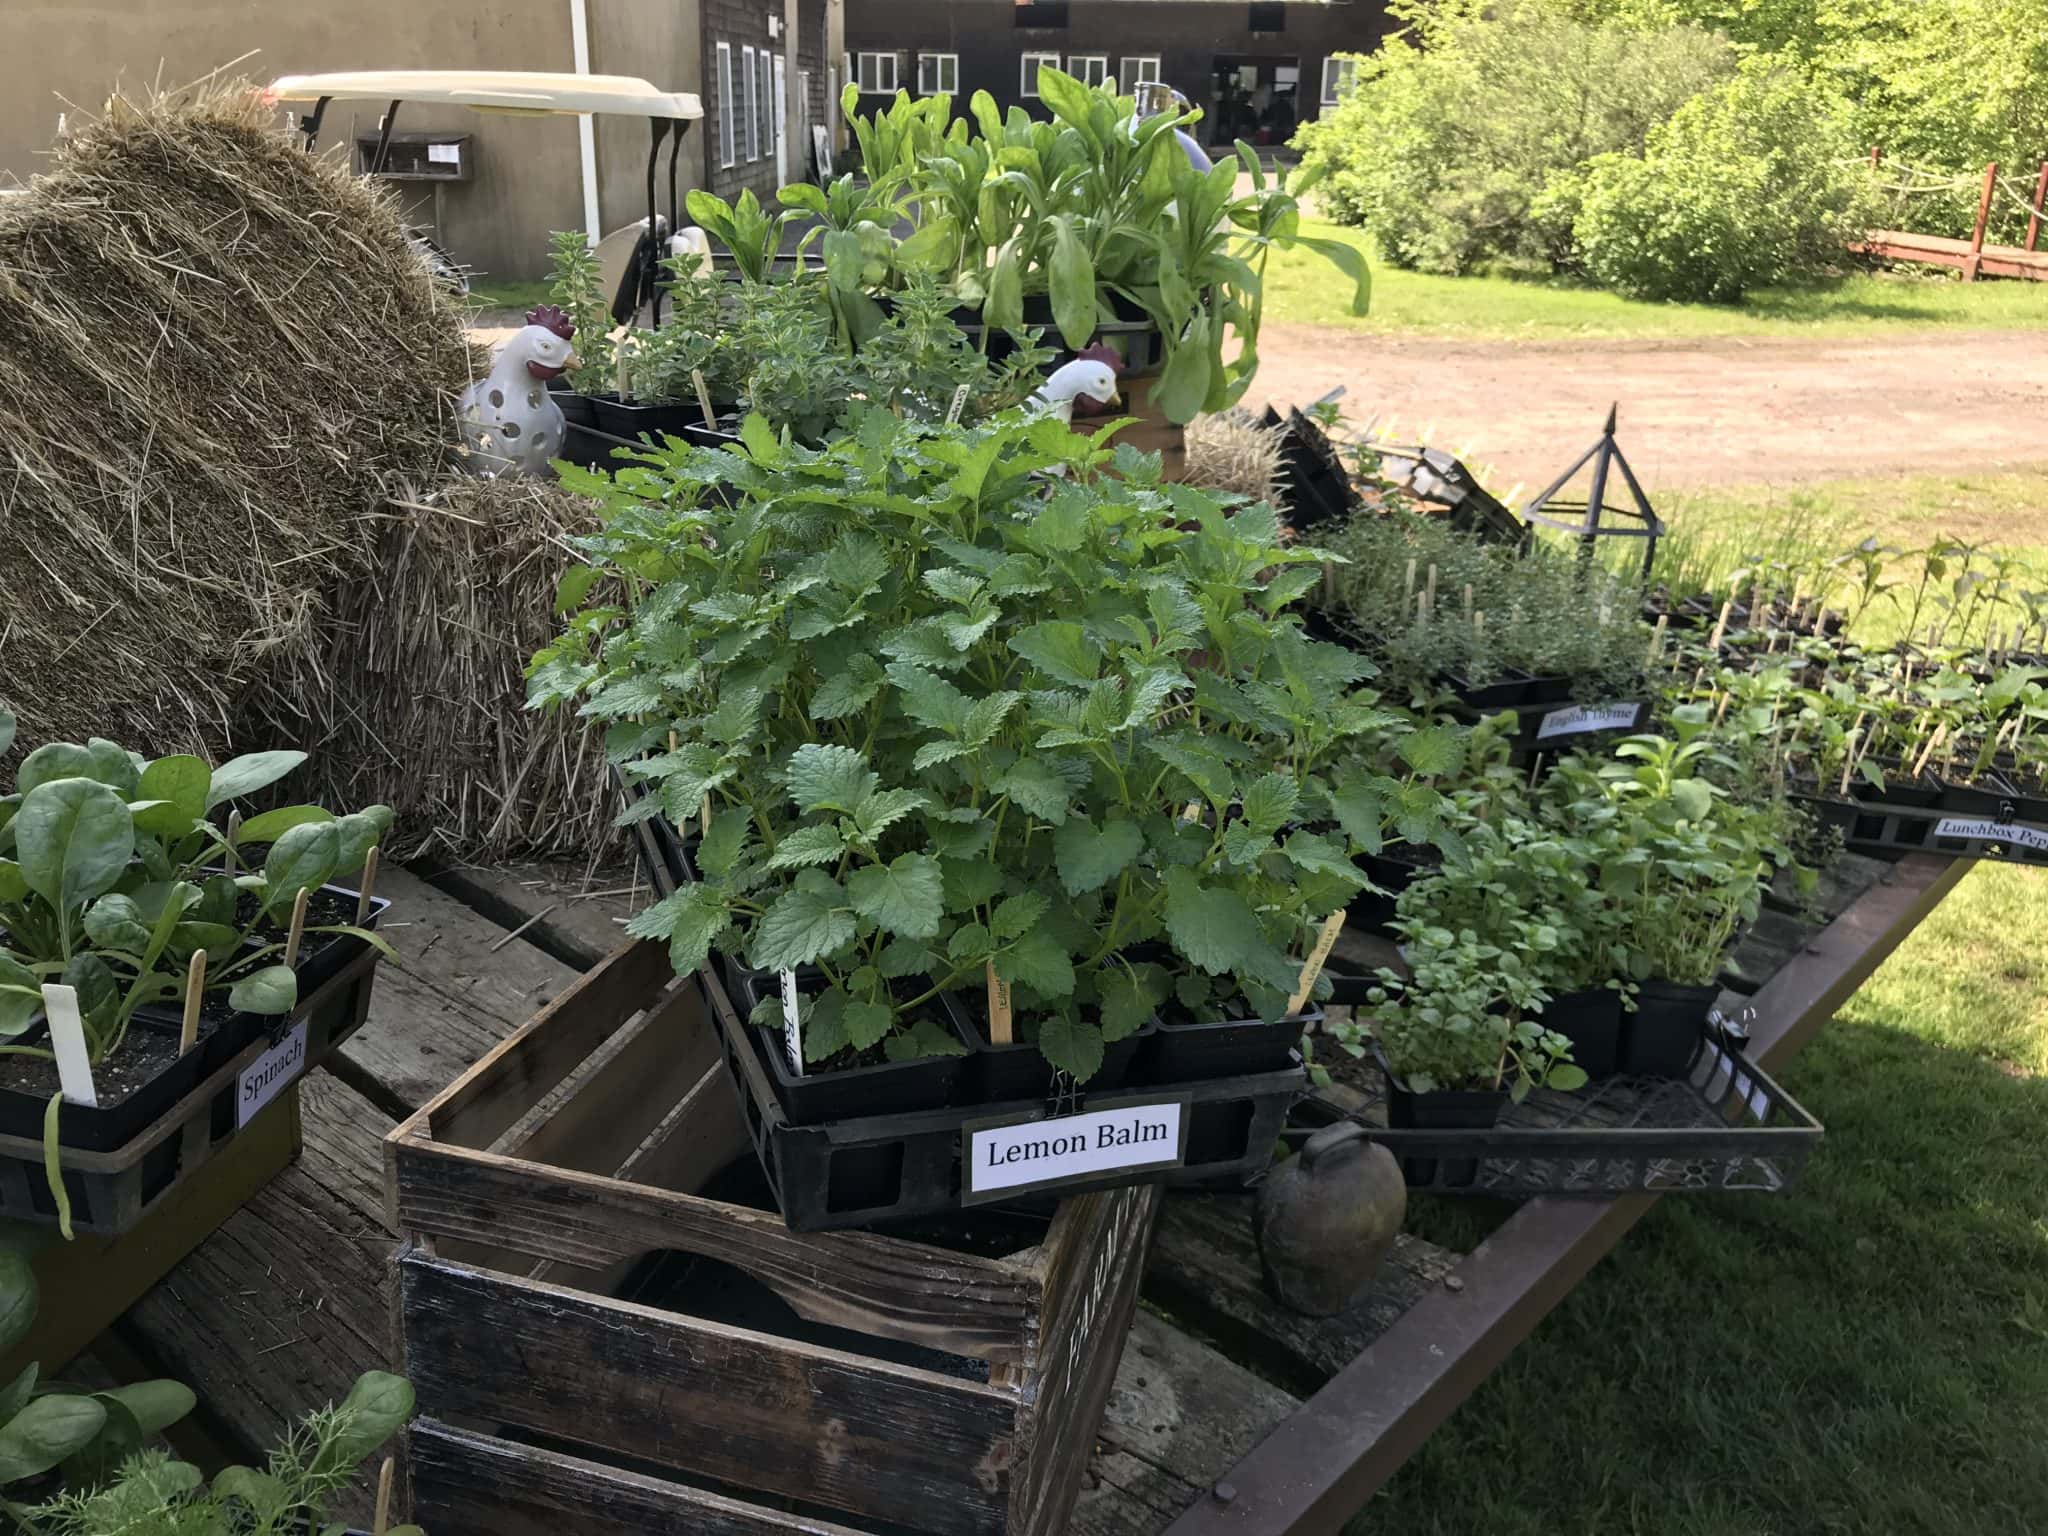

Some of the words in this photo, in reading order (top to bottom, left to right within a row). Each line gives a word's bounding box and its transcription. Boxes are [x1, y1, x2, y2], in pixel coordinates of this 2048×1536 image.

[1942, 821, 2014, 839] Lunchbox
[2019, 829, 2048, 849] Pep
[244, 1038, 302, 1101] Spinach
[987, 1133, 1087, 1167] Lemon
[1096, 1119, 1168, 1149] Balm
